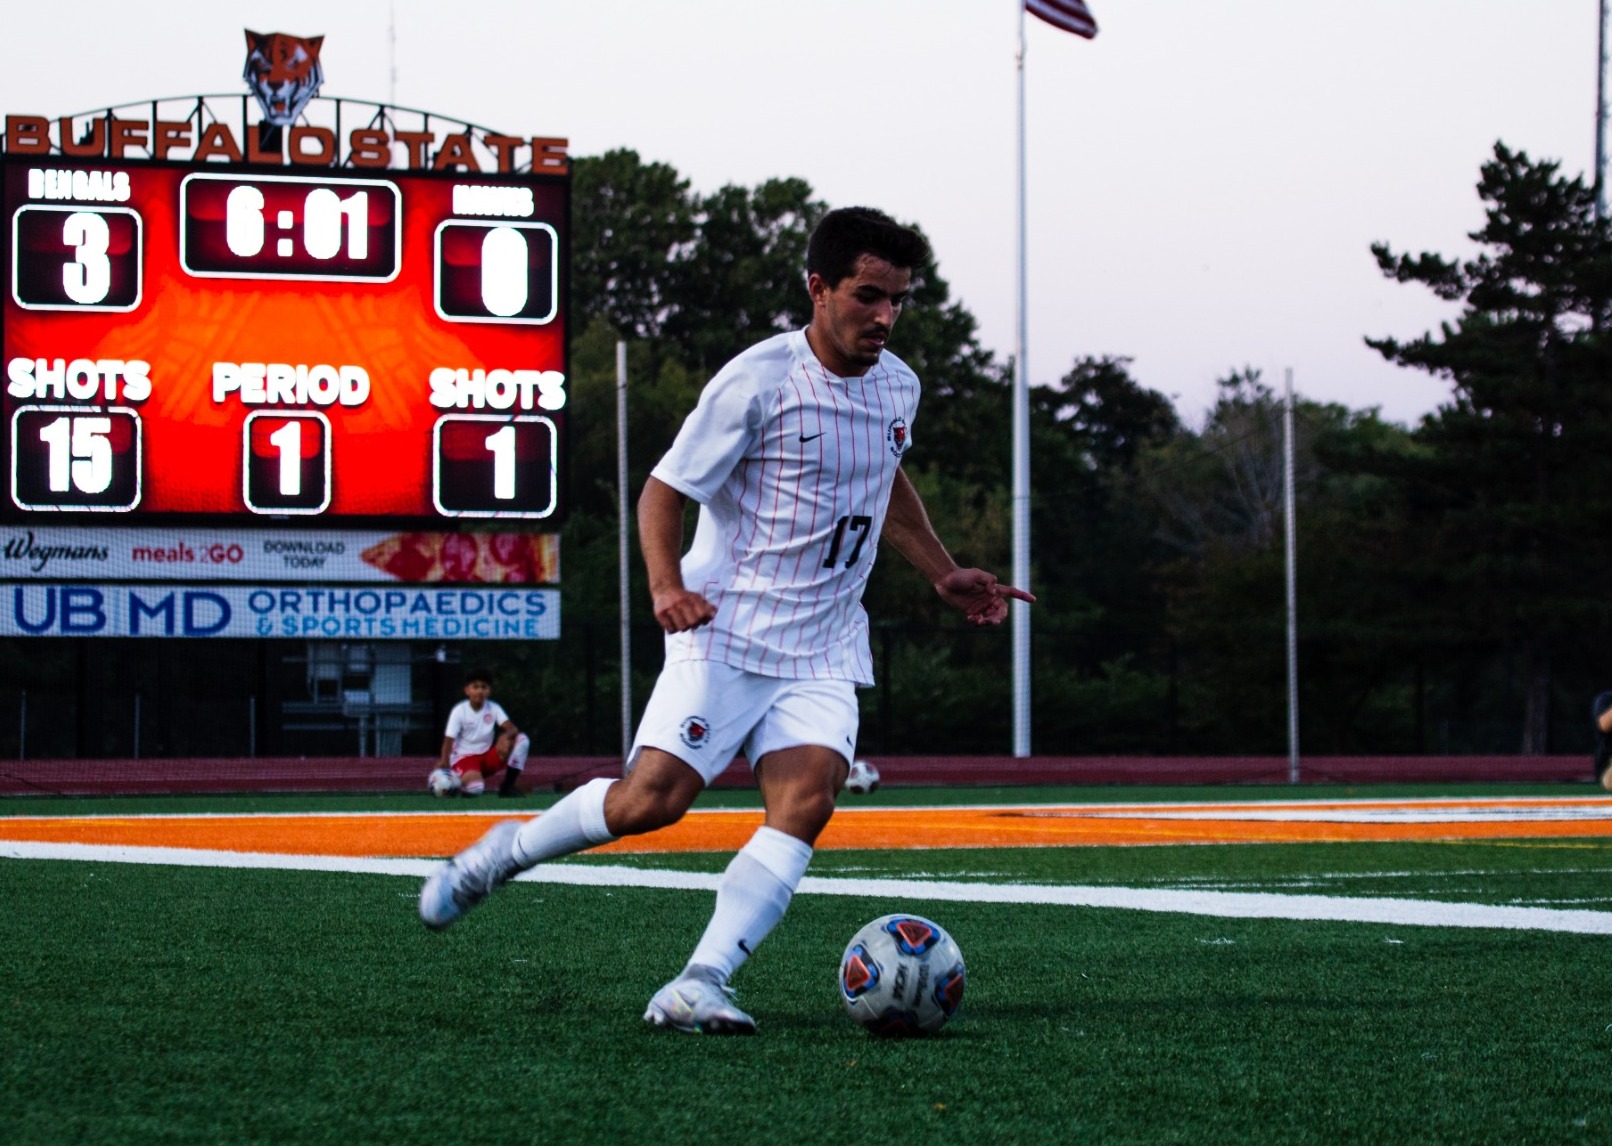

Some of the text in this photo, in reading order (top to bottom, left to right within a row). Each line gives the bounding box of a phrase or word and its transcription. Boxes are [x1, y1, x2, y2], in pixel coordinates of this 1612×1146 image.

[5, 115, 569, 175] BUFFALO STATE
[226, 185, 369, 260] 6:01
[63, 212, 110, 304] 3
[481, 227, 528, 317] 0
[7, 358, 152, 402] SHOTS
[212, 363, 371, 406] PERIOD
[430, 368, 566, 411] SHOTS
[40, 417, 112, 493] 15
[271, 421, 301, 495] 1
[485, 426, 515, 500] 1
[3, 531, 109, 572] Wegmans
[132, 542, 194, 563] meals
[263, 540, 345, 555] DOWNLOAD
[284, 556, 326, 569] TODAY
[822, 515, 873, 569] 17
[248, 590, 547, 616] ORTHOPAEDICS
[256, 616, 539, 637] & SPORTS MEDICINE
